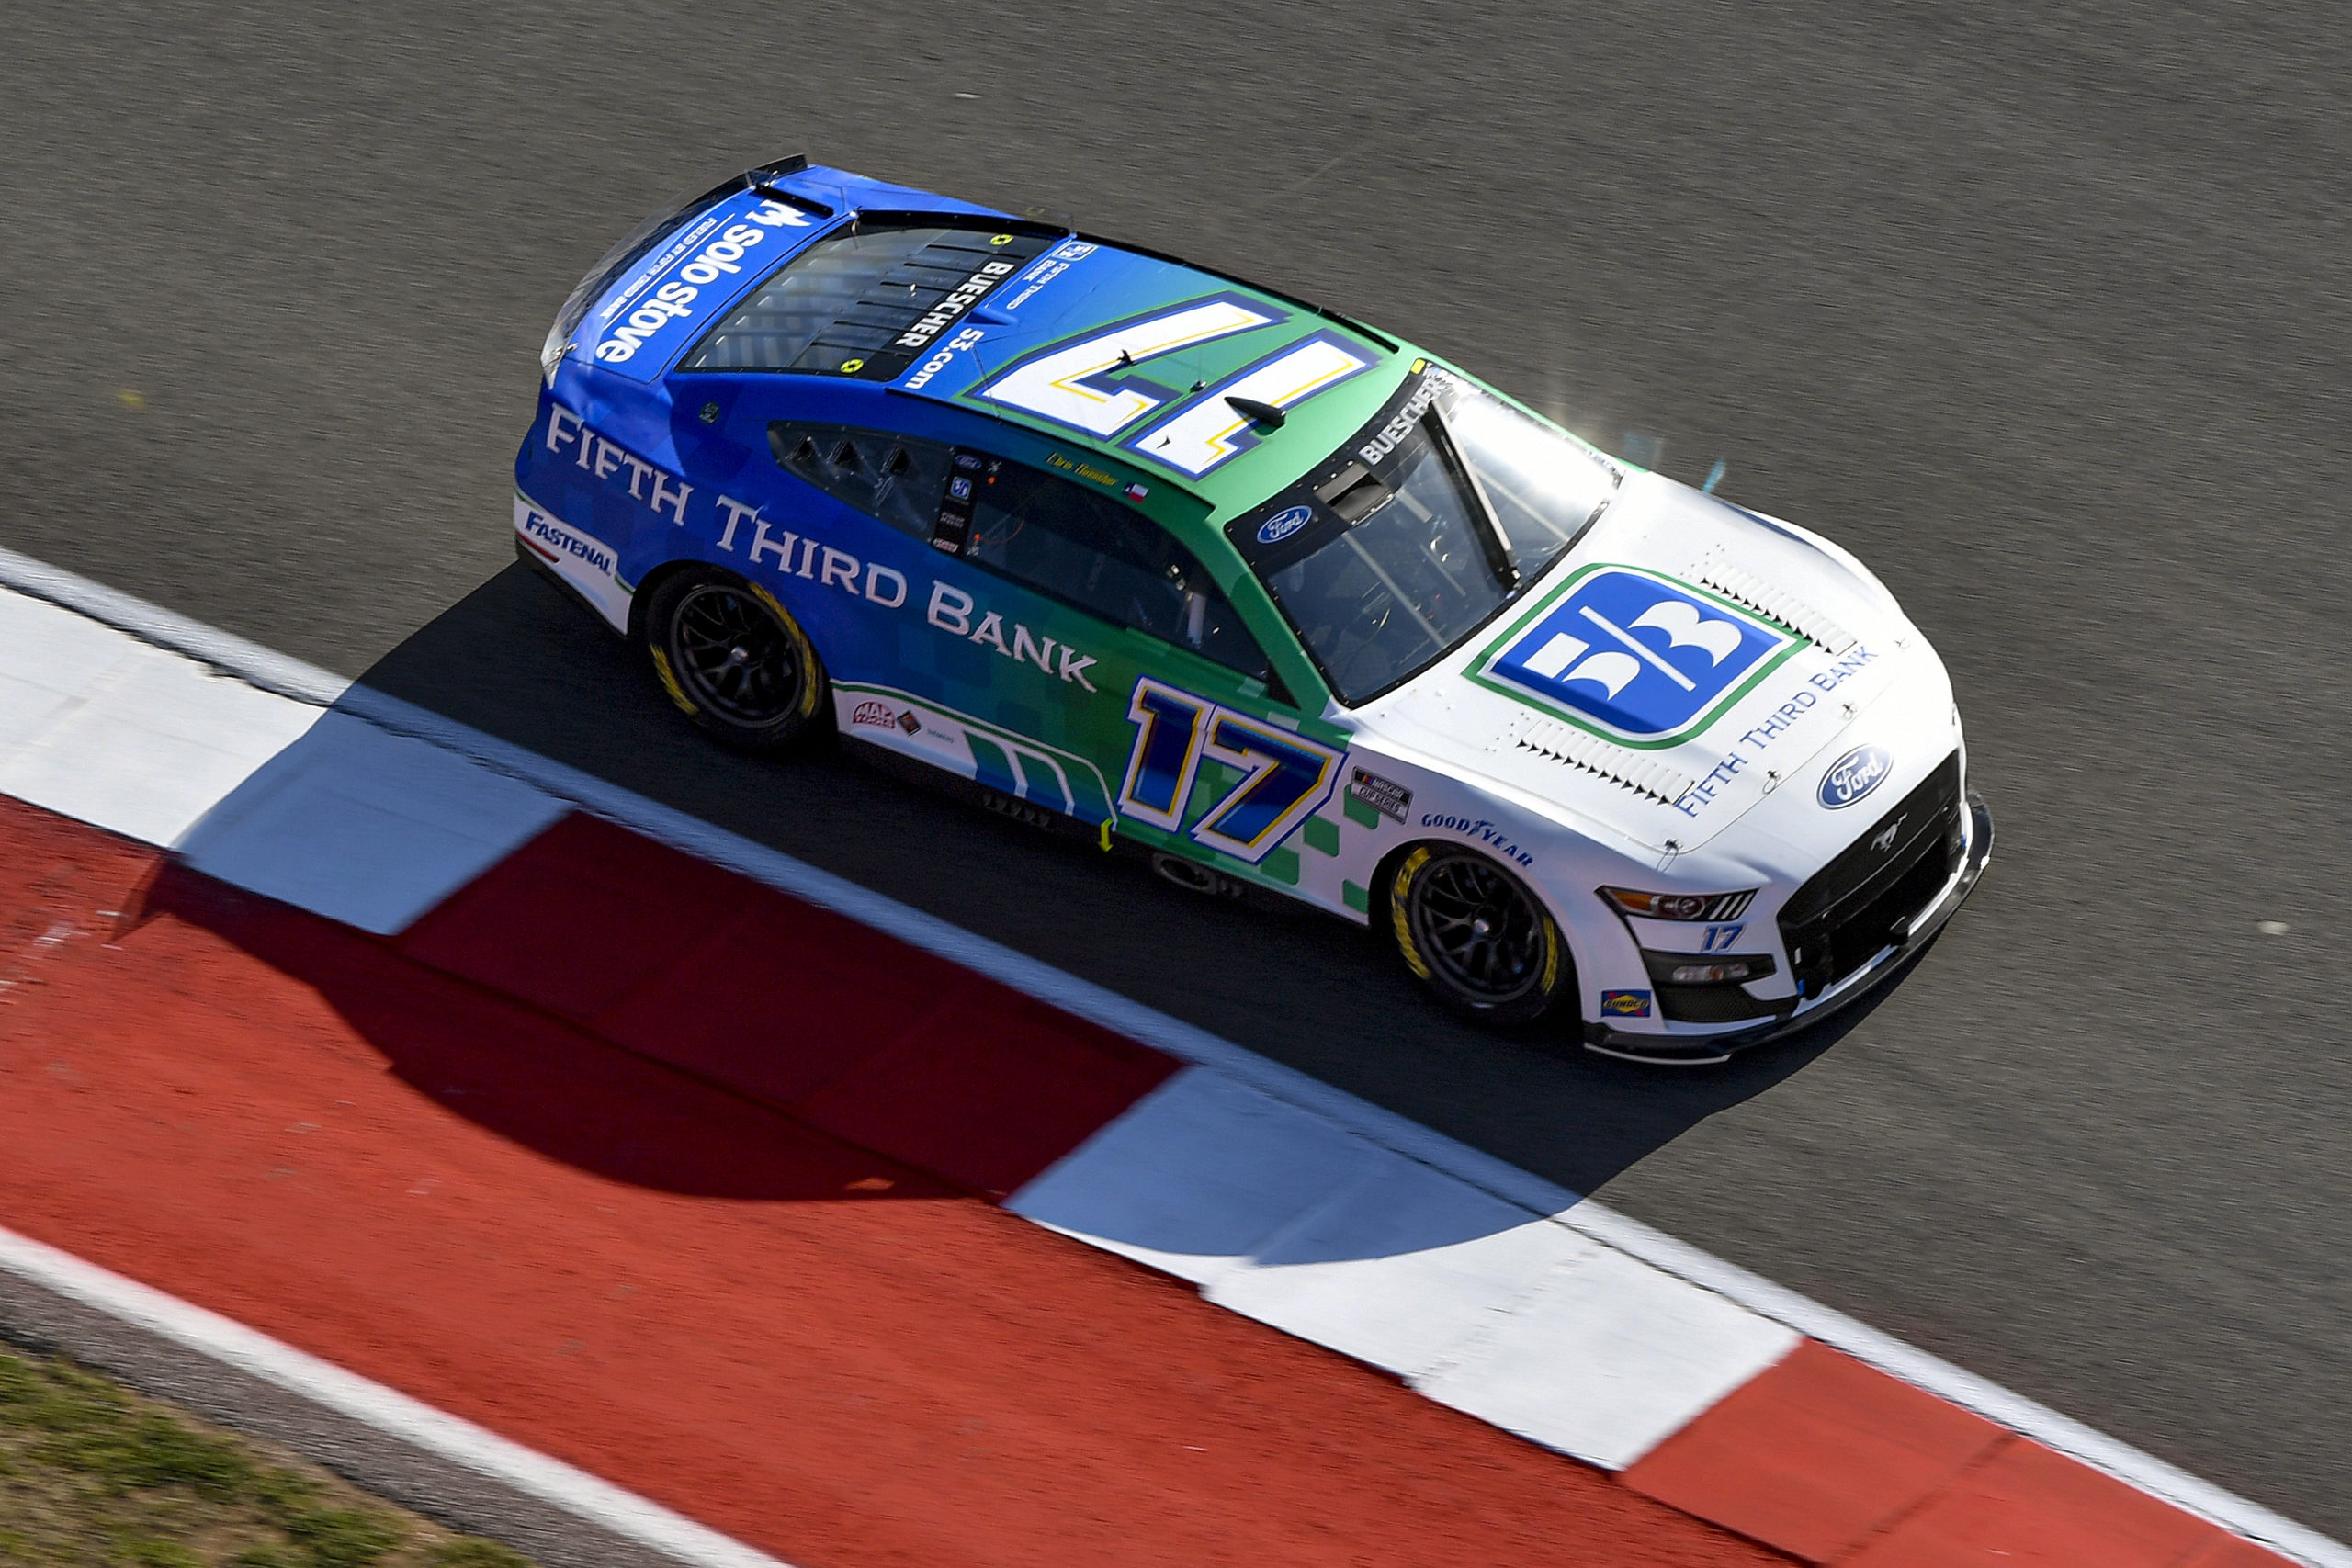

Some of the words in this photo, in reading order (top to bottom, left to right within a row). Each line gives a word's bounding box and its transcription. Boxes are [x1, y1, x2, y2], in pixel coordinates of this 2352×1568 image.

[680, 224, 765, 285] solo
[595, 281, 698, 363] stove
[895, 261, 1015, 347] BUESCHER
[905, 327, 985, 389] 53.com
[525, 511, 612, 577] FASTENAL
[546, 402, 695, 526] FIFTH
[715, 493, 908, 610] THIRD
[926, 579, 1099, 694] BANK
[1267, 512, 1305, 539] Ford
[1676, 751, 1749, 818] FIFTH
[1739, 689, 1817, 752] THIRD
[1814, 645, 1880, 691] BANK
[1118, 674, 1350, 865] 17
[1827, 754, 1884, 804] Ford
[1420, 813, 1535, 868] GOODYEAR
[1701, 923, 1747, 953] 17
